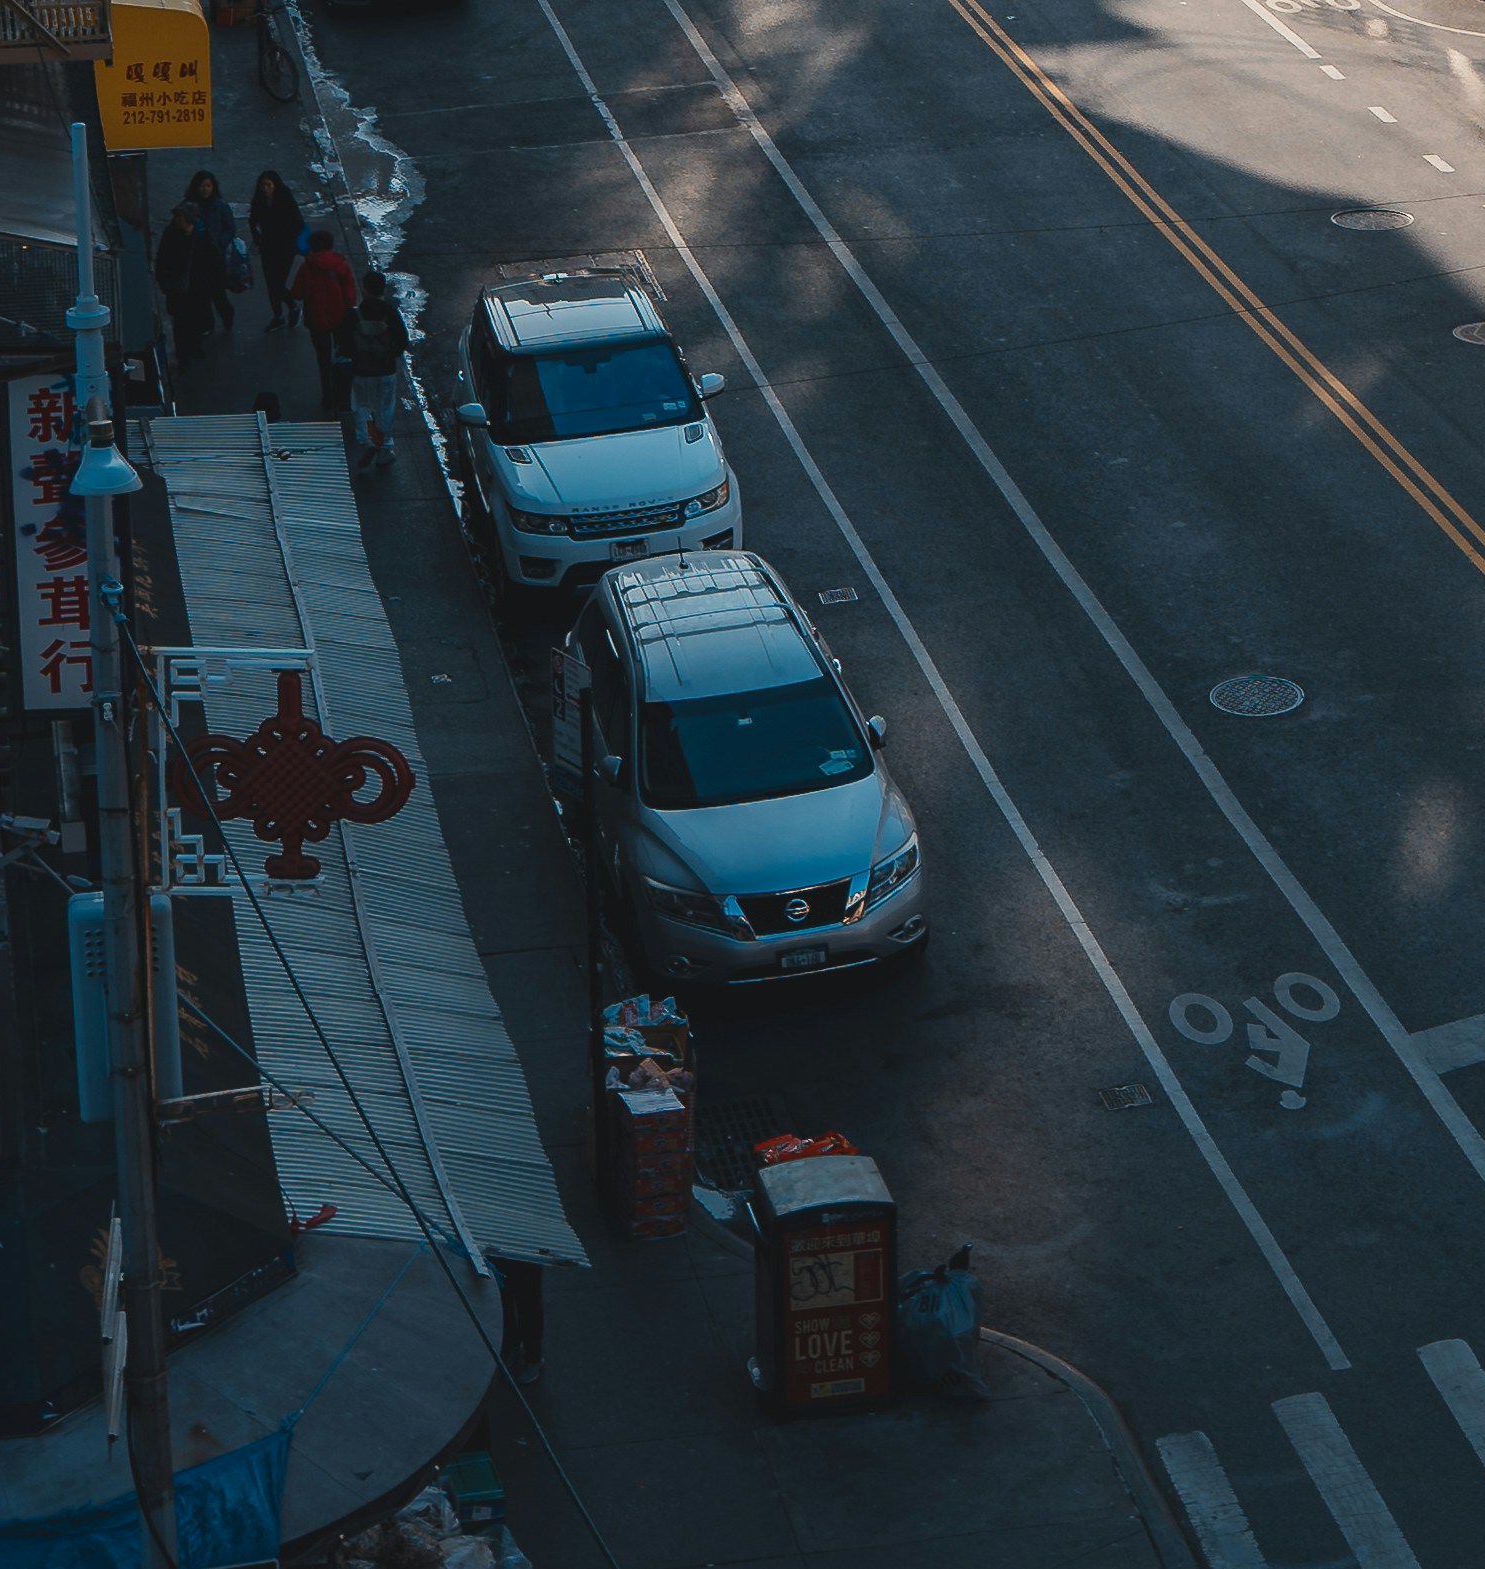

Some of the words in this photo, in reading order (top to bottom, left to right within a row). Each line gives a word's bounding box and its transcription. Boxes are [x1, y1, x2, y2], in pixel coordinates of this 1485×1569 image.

[121, 90, 207, 107] 福州小吃店
[123, 108, 205, 125] 212-791-2819
[572, 505, 620, 514] RANGE
[795, 1317, 831, 1335] SHOW
[795, 1329, 854, 1361] LOVE
[815, 1356, 855, 1374] CLEAN
